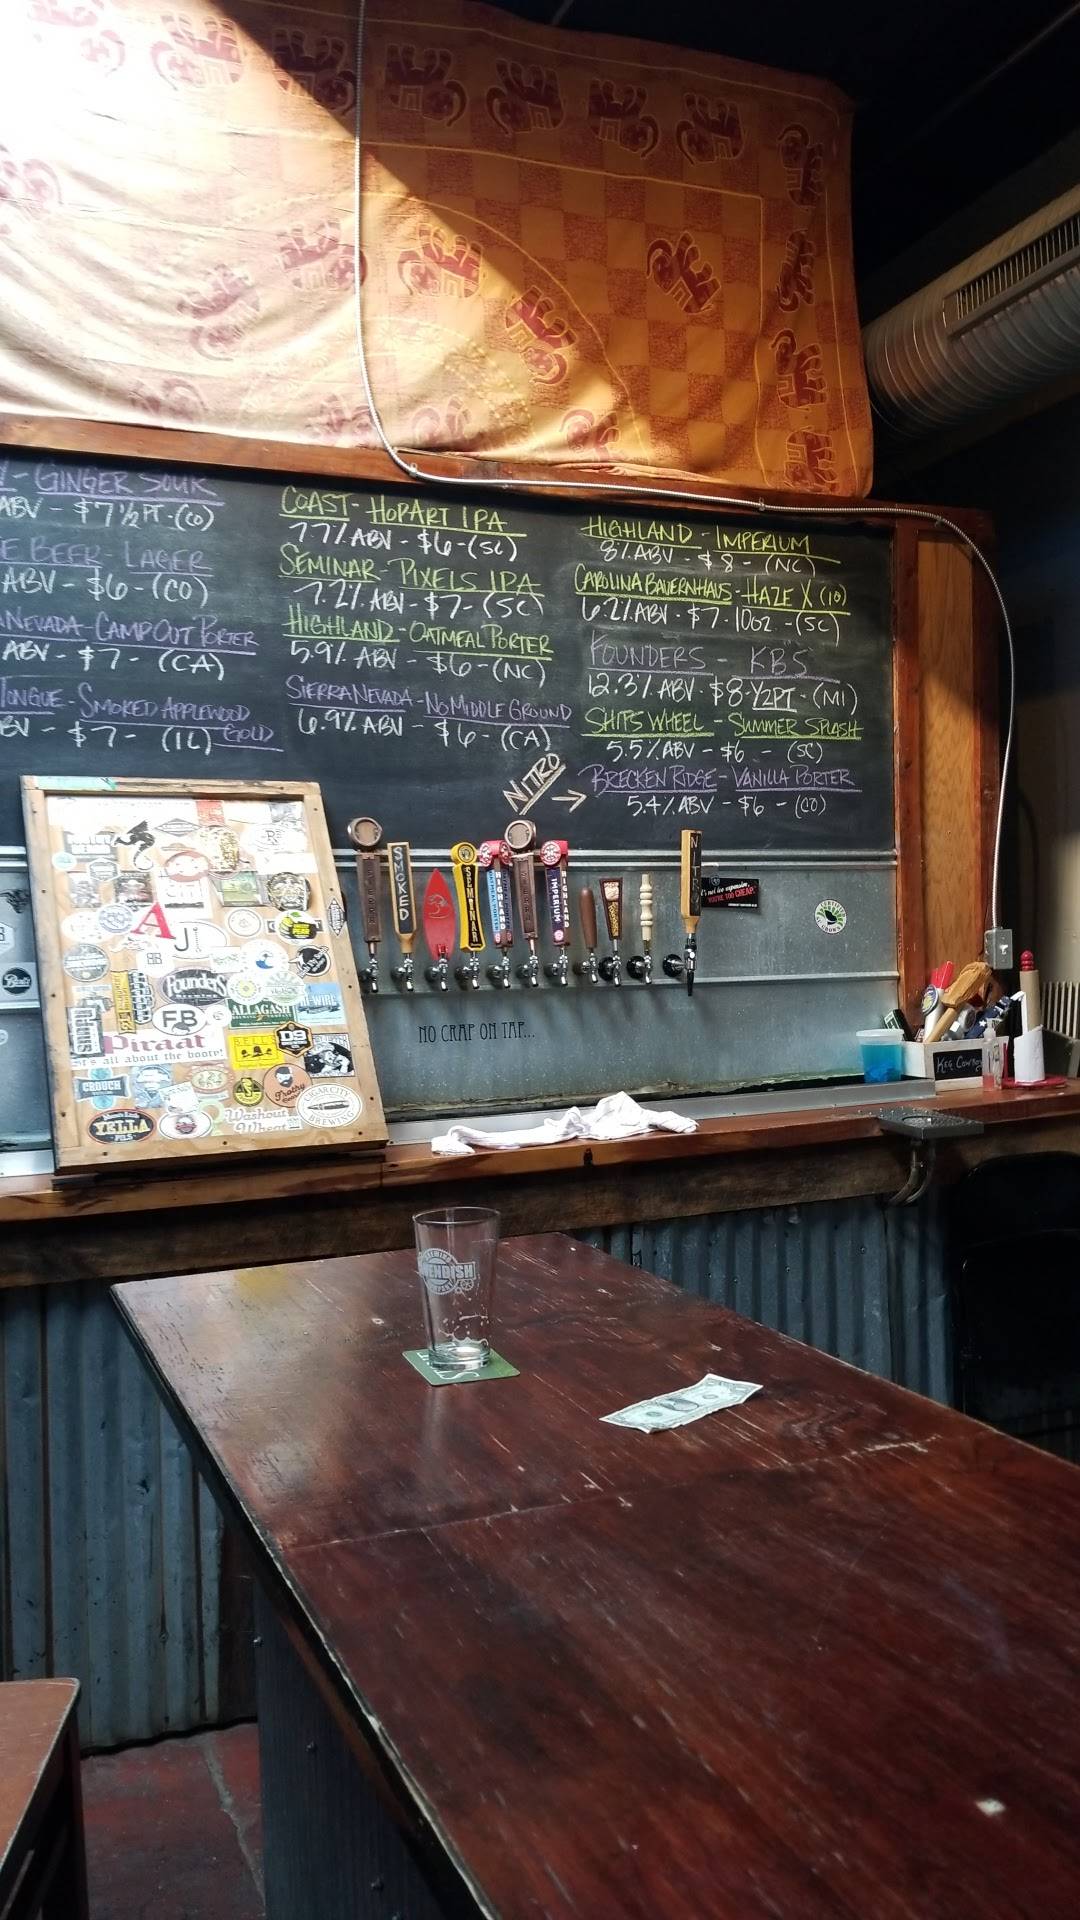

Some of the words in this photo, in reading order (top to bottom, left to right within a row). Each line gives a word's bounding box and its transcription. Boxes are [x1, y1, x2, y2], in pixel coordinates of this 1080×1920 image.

[35, 464, 133, 494] GINGER
[280, 486, 352, 516] COAST
[462, 506, 508, 531] IPA
[349, 529, 392, 550] ABV
[580, 515, 693, 544] HIGHLAND
[716, 526, 810, 554] IMPERIUM
[31, 536, 102, 566] BEER
[124, 540, 213, 570] LAGER
[633, 544, 674, 564] ABV
[1, 567, 56, 594] ABV
[279, 542, 381, 581] SEMINAR
[387, 557, 478, 591] PIXELS
[489, 569, 541, 596] IPA
[370, 587, 405, 615] ABV
[741, 574, 793, 608] HAZE
[634, 602, 668, 625] ABV
[282, 603, 394, 640] HIGHLAND
[409, 621, 486, 649] OATMEAL
[481, 621, 555, 654] PORTER
[1, 640, 50, 662] ABV
[353, 646, 397, 670] ABV
[590, 630, 706, 670] FOUNDERS
[750, 646, 814, 677] KBS
[77, 682, 159, 719] SMOKED
[656, 676, 696, 703] ABV
[508, 703, 573, 722] GROUND
[647, 707, 705, 734] WHEEL
[727, 711, 801, 737] SUMMER
[804, 717, 865, 737] SPLASH
[0, 715, 29, 738] BV
[362, 714, 403, 737] ABV
[662, 741, 696, 760] ABV
[502, 752, 561, 813] NITRO
[730, 764, 790, 788] VANILLA
[789, 764, 856, 787] PORTER
[678, 794, 715, 815] ABV
[393, 846, 410, 921] SMOKED
[464, 866, 479, 943] SEMINAR
[495, 871, 506, 930] HIGHLAND
[551, 878, 562, 923] IMPERIUM
[561, 870, 570, 928] HIGHLAND
[166, 972, 229, 997] Founders
[231, 1004, 291, 1015] ALLAGASH
[103, 1033, 206, 1055] Piraat
[418, 1025, 437, 1043] NO
[441, 1023, 475, 1042] CRAP
[479, 1022, 497, 1040] ON
[124, 1054, 159, 1064] about
[82, 1079, 122, 1092] CROUCH
[92, 1118, 151, 1136] YELLA
[225, 1107, 288, 1122] Washout
[307, 1111, 355, 1126] BREWING
